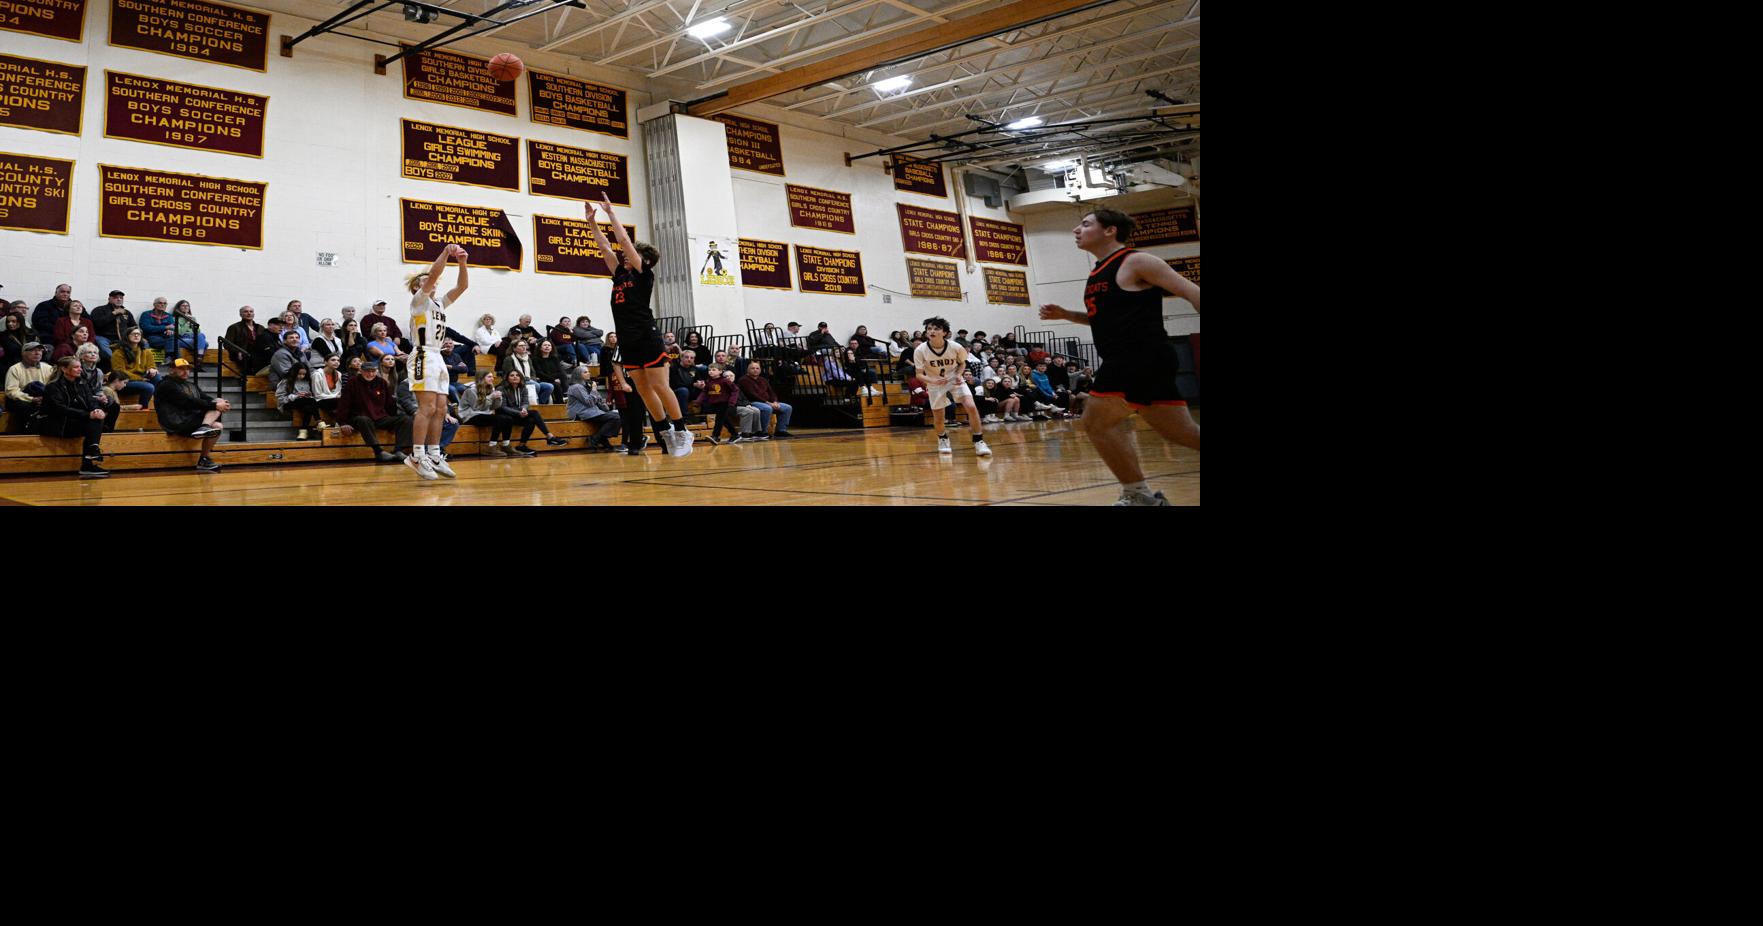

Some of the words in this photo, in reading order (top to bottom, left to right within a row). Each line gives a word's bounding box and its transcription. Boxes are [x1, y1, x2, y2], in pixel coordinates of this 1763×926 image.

[171, 0, 227, 16] MEMORIAL
[118, 0, 184, 19] SOUTHERN
[188, 13, 262, 34] CONFERENCE
[139, 14, 178, 28] BOYS
[185, 24, 243, 40] SOCCER
[137, 25, 243, 52] CHAMPIONS
[170, 43, 210, 56] 1984
[422, 58, 465, 71] SOUTHERN
[421, 64, 445, 75] GIRLS
[449, 70, 499, 86] BASKETBALL
[115, 77, 159, 89] LENOX
[166, 84, 228, 100] MEMORIAL
[428, 74, 495, 94] CHAMPIONS
[546, 82, 582, 96] SOUTHERN
[585, 91, 612, 102] DIVISION
[10, 85, 74, 102] COUNTRY
[539, 90, 562, 100] BOYS
[566, 95, 619, 112] BASKETBALL
[112, 87, 178, 103] SOUTHERN
[185, 98, 261, 117] CONFERENCE
[553, 101, 608, 117] CHAMPIONS
[128, 101, 171, 114] BOYS
[180, 108, 245, 125] SOCCER
[131, 114, 241, 137] CHAMPIONS
[166, 131, 207, 143] 1987
[412, 123, 432, 132] LENOX
[436, 128, 467, 138] MEMORIAL
[488, 136, 511, 145] SCHOOL
[726, 127, 772, 142] CHAMPIONS
[439, 135, 487, 150] LEAGUE
[424, 142, 454, 154] GIRLS
[457, 147, 501, 160] SWIMMING
[429, 153, 494, 169] CHAMPIONS
[542, 151, 567, 163] WESTERN
[570, 156, 616, 169] MASSACHUSETTS
[406, 166, 434, 178] BOYS
[538, 160, 562, 170] BOYS
[565, 164, 620, 179] BASKETBALL
[108, 172, 139, 181] LENOX
[146, 176, 194, 187] MEMORIAL
[200, 181, 220, 190] HIGH
[226, 185, 260, 194] SCHOOL
[552, 172, 609, 186] CHAMPIONS
[44, 188, 64, 198] SKI
[105, 183, 174, 196] SOUTHERN
[182, 190, 260, 206] CONFERENCE
[109, 196, 145, 206] GIRLS
[151, 200, 192, 211] CROSS
[200, 204, 256, 217] COUNTRY
[436, 206, 469, 215] MEMORIAL
[127, 211, 240, 229] CHAMPIONS
[438, 214, 490, 226] LEAGUE
[800, 210, 844, 222] CHAMPIONS
[163, 226, 206, 238] 1988
[420, 222, 443, 232] BOYS
[447, 225, 479, 235] ALPINE
[481, 228, 506, 238] SKIIN
[904, 219, 924, 228] STATE
[927, 222, 960, 233] CHAMPIONS
[429, 233, 500, 247] CHAMPIONS
[549, 236, 570, 245] GIRLS
[975, 230, 991, 238] STATE
[993, 232, 1022, 242] CHAMPIONS
[803, 255, 822, 264] STATE
[824, 257, 855, 268] CHAMPIONS
[803, 272, 818, 281] GIRLS
[820, 274, 836, 283] CROSS
[837, 275, 858, 284] COUNTRY
[913, 268, 929, 276] STATE
[930, 269, 955, 278] CHAMPIONS
